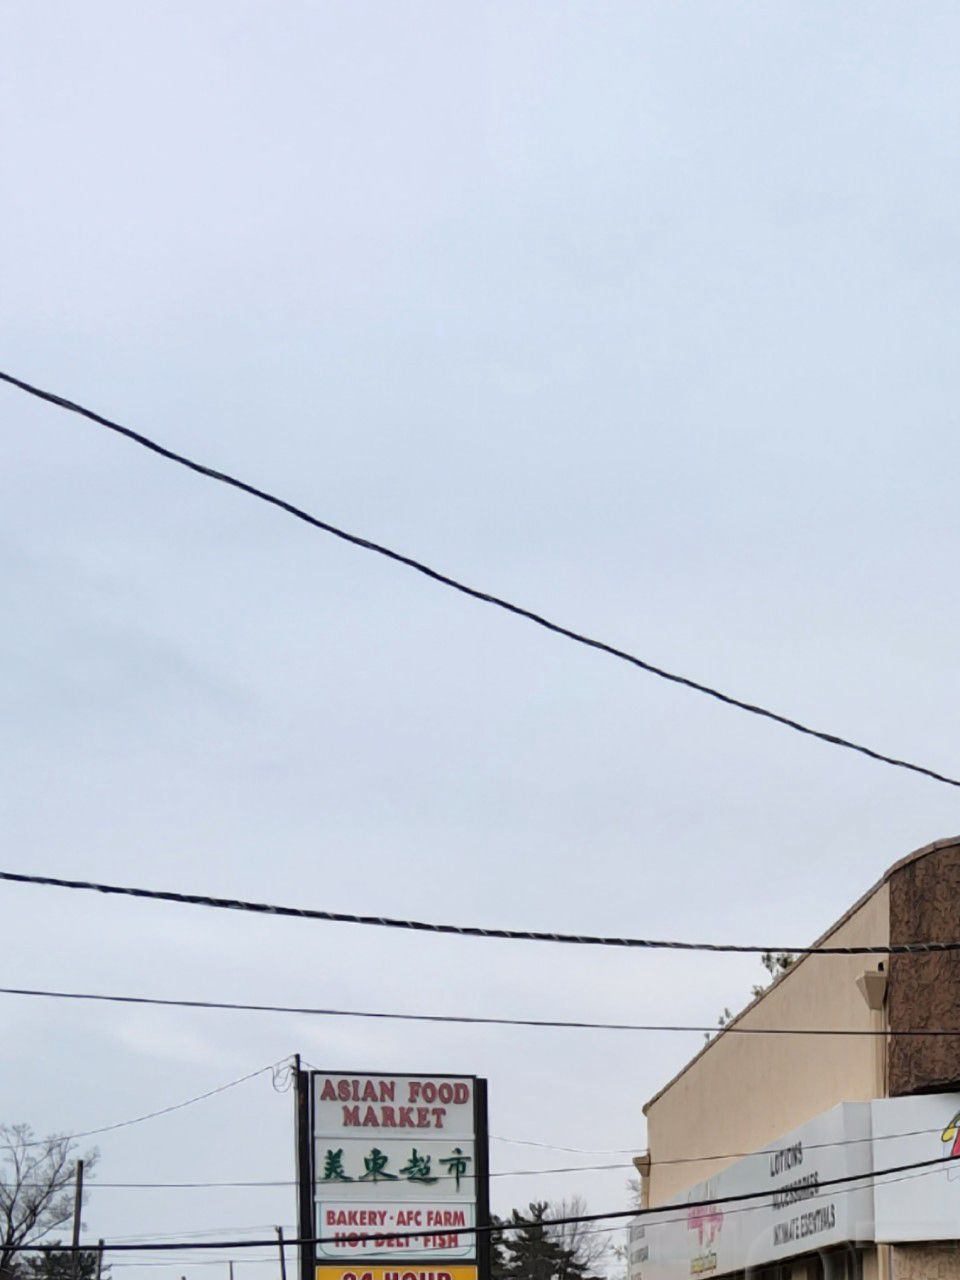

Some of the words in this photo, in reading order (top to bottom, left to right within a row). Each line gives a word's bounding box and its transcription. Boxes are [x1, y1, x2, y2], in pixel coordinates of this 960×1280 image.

[320, 1078, 396, 1103] ASIAN
[407, 1080, 470, 1105] FOOD
[342, 1105, 446, 1128] MARKET
[320, 1148, 472, 1193] 美東超市
[326, 1210, 387, 1227] BAKERY
[396, 1210, 422, 1227] AFC
[427, 1210, 465, 1227] FARM
[334, 1231, 368, 1248] HOT
[374, 1231, 411, 1248] DELI
[423, 1231, 459, 1248] FISH
